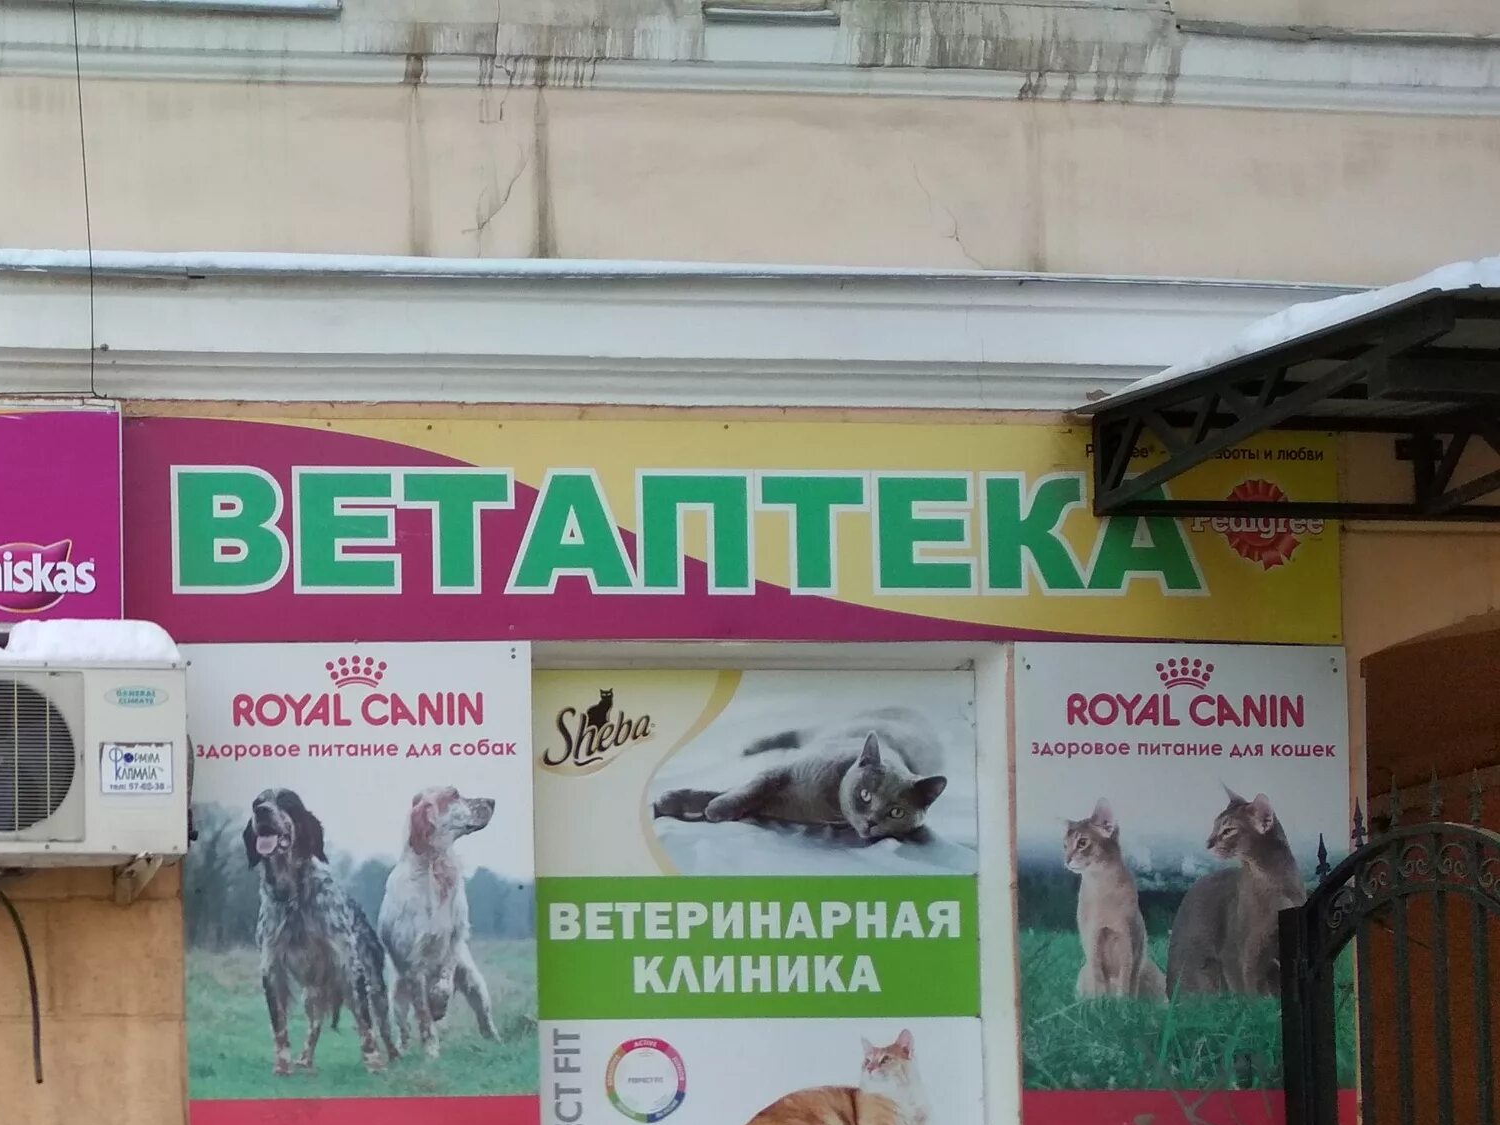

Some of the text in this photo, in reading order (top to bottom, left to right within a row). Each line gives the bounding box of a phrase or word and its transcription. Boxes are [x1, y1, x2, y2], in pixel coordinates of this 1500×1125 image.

[1208, 447, 1260, 461] аботы
[1277, 447, 1324, 462] любви
[169, 464, 1210, 597] ВЕТАПТЕКА
[232, 691, 484, 727] ROYAL CANIN
[1067, 692, 1305, 728] ROYAL CANIN
[196, 739, 517, 759] здоровое питание для собак
[542, 706, 651, 768] Sheba
[1031, 741, 1336, 758] здоровое питание для кошек
[548, 900, 961, 941] ВЕТЕРИНАРНАЯ
[632, 955, 882, 994] КЛИНИКА
[552, 1028, 581, 1074] FIT
